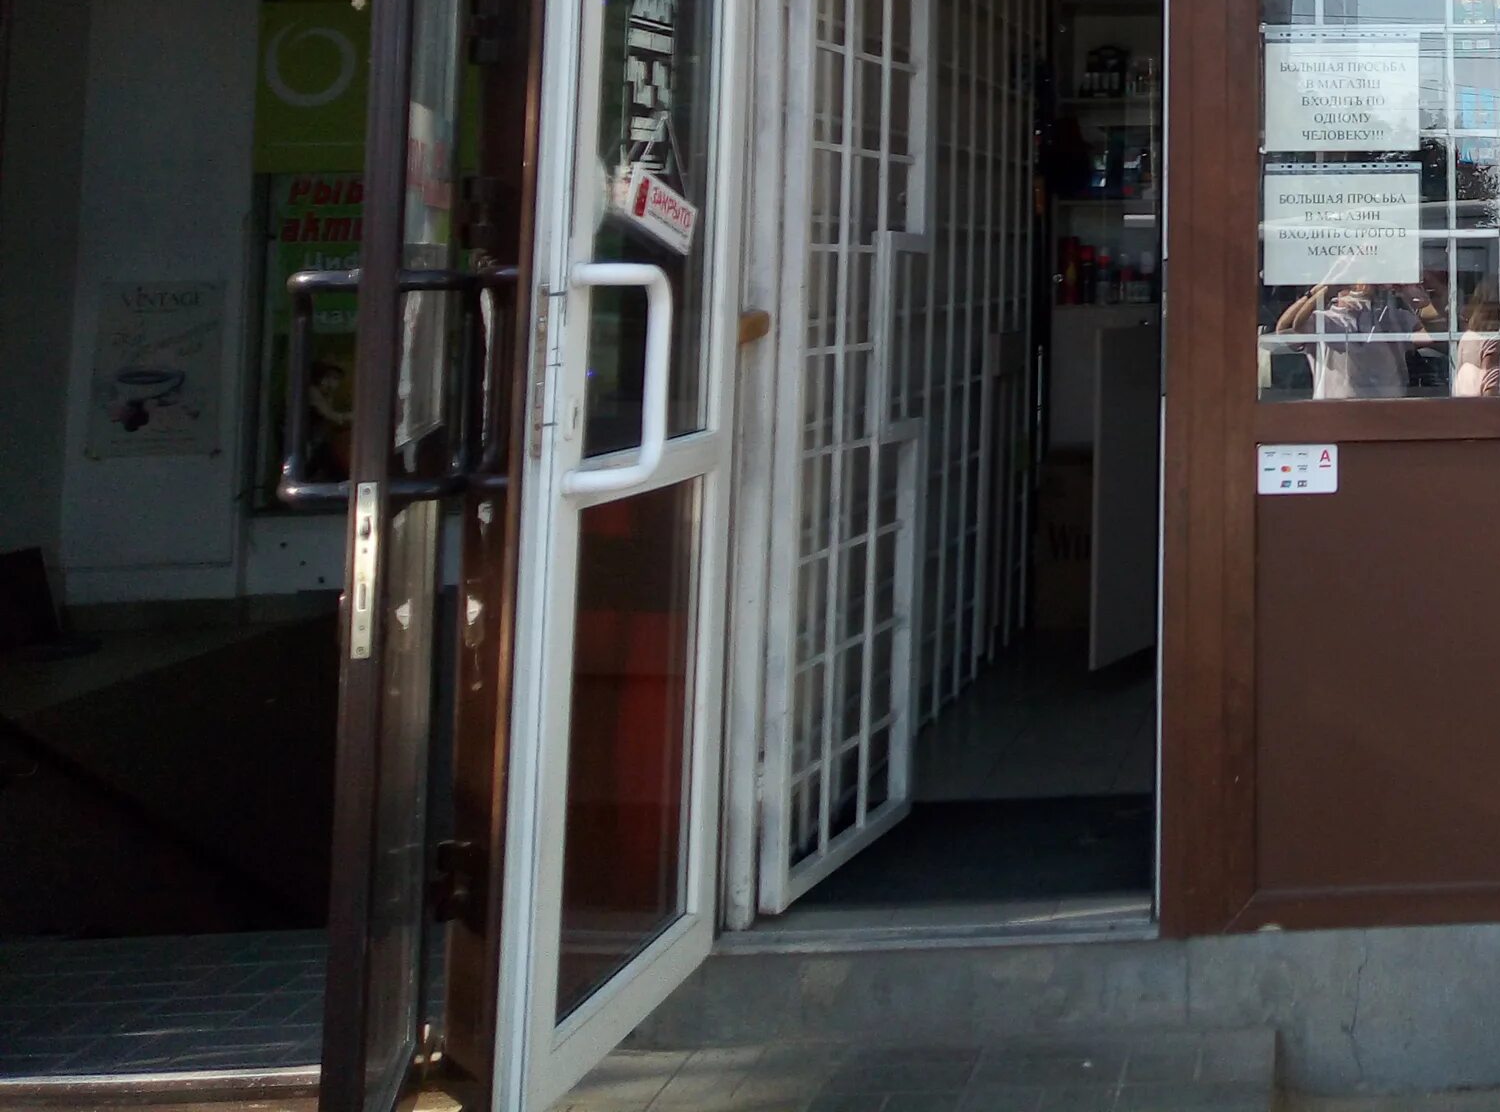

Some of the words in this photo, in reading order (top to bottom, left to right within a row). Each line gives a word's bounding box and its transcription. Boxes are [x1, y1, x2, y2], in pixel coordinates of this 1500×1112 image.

[1313, 113, 1372, 125] ОДНОМУ
[1279, 193, 1344, 205] БОЛЬШАЯ
[1304, 210, 1313, 221] В
